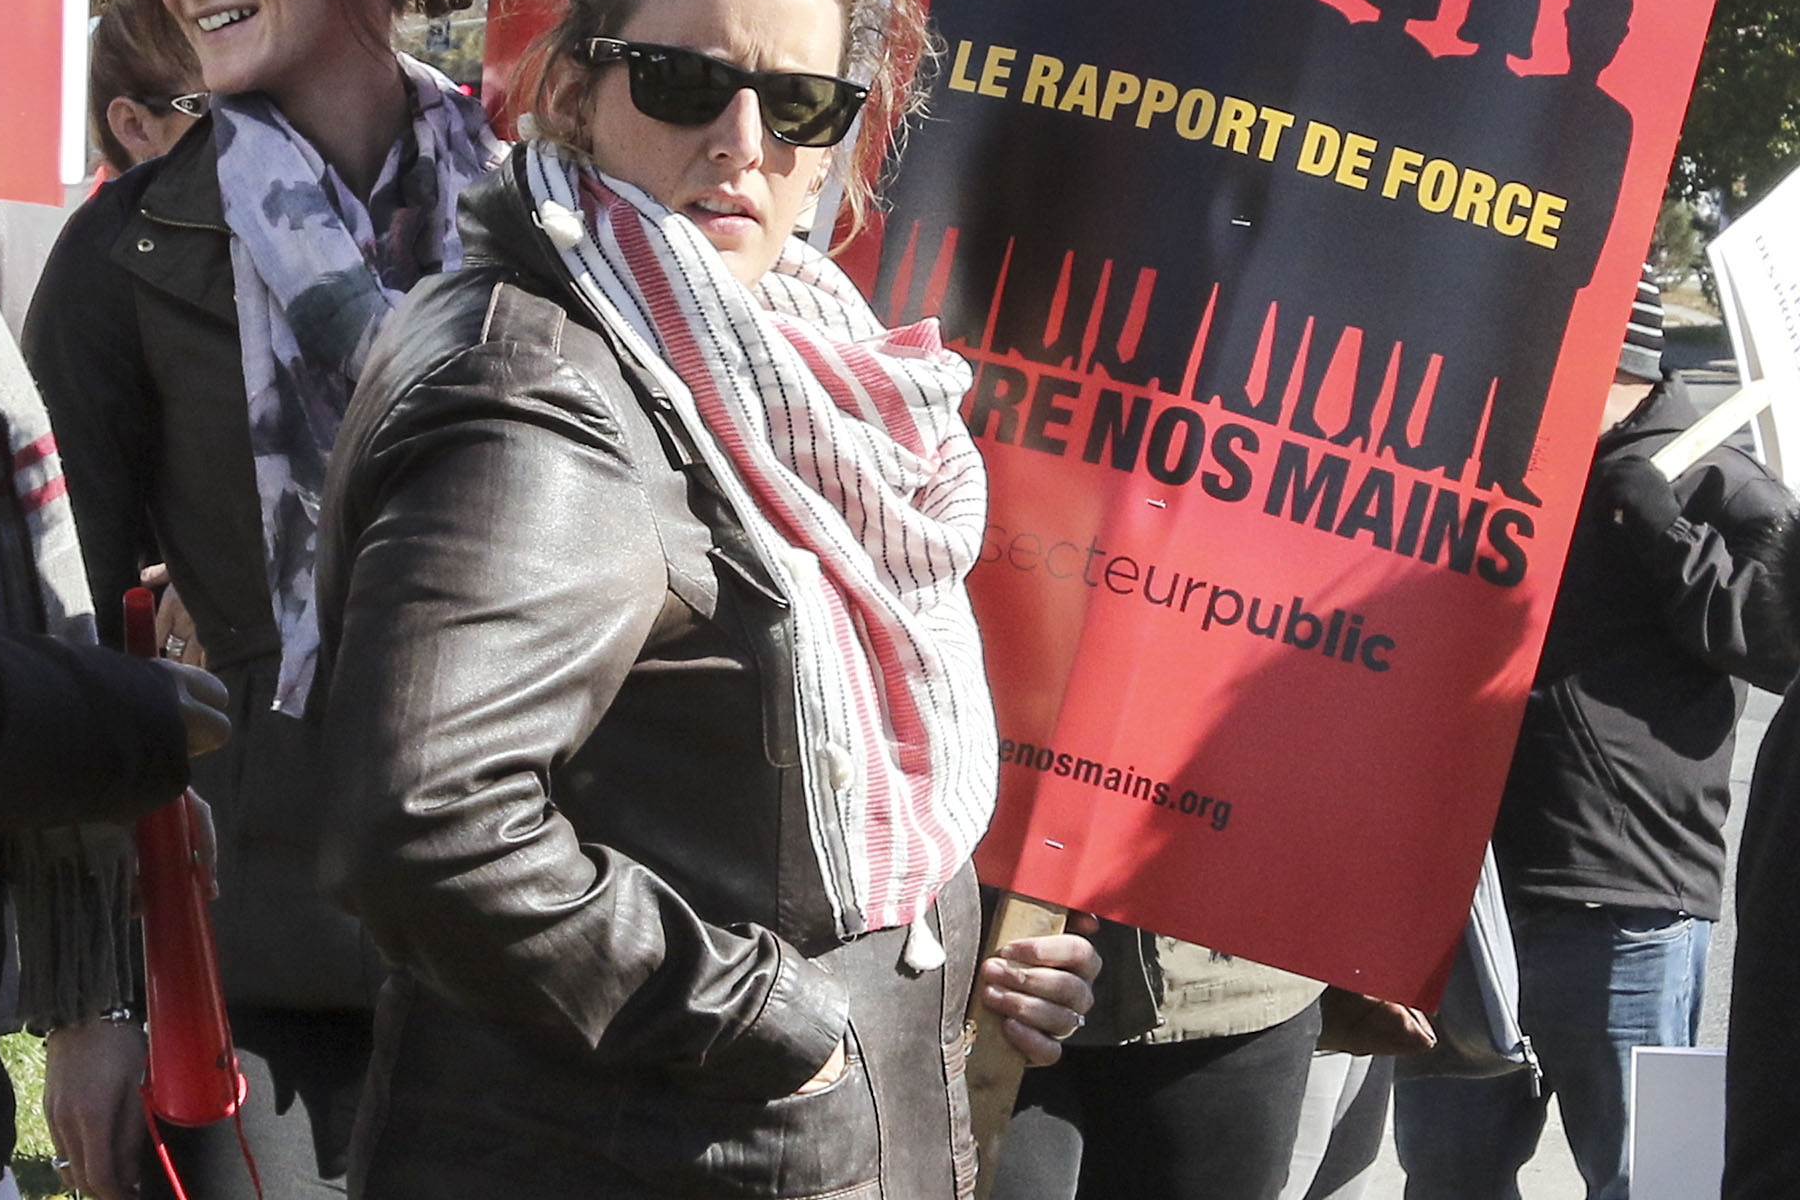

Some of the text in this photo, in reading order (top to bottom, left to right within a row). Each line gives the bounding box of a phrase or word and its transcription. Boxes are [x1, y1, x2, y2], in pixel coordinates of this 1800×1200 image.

[948, 40, 1567, 251] LE RAPPORT DE FORCE
[1081, 390, 1260, 503] NOS
[1262, 441, 1535, 589] MAINS
